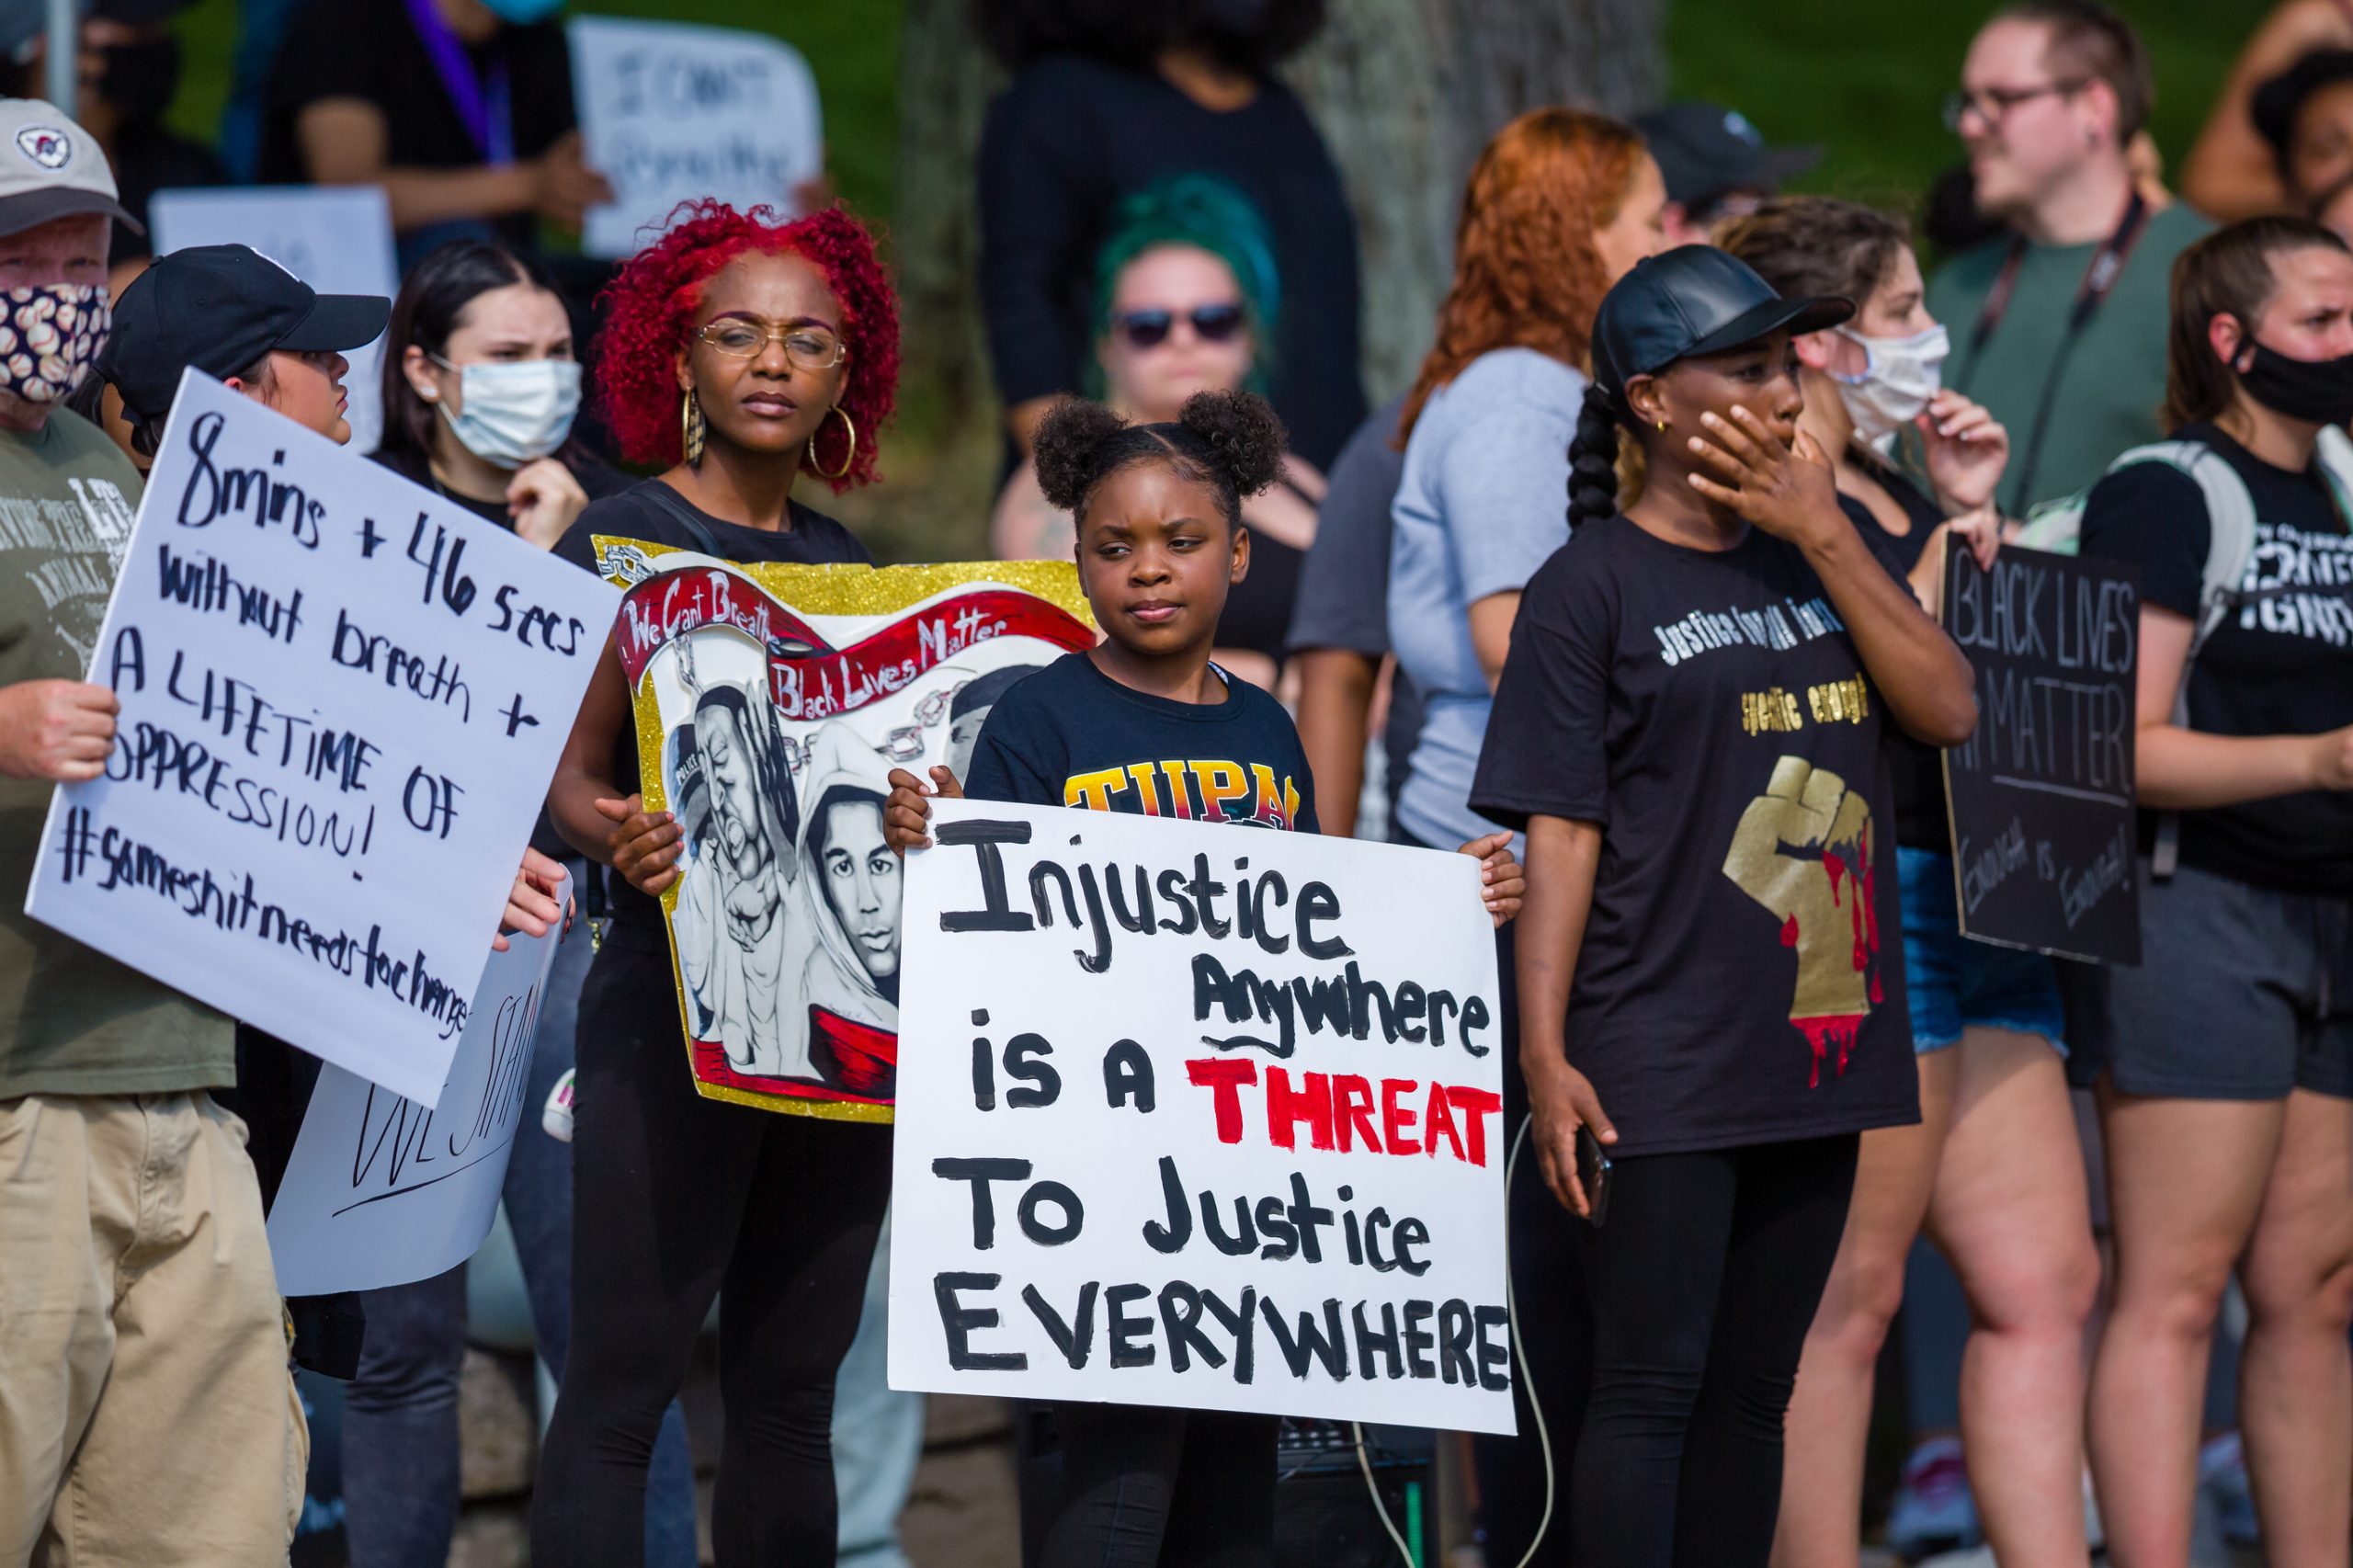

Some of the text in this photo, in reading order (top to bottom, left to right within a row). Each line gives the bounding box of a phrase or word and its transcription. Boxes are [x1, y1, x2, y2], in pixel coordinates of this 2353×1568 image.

[176, 411, 326, 551] 8mins
[406, 511, 476, 616] 46
[487, 585, 585, 656] secs
[158, 544, 303, 644] without
[332, 608, 470, 723] breath
[622, 597, 661, 653] We
[771, 606, 1008, 721] Black Lives Matter
[1654, 608, 1744, 667] Justice
[1951, 545, 2048, 660] BLACK
[2057, 569, 2135, 675] LIVES
[110, 626, 466, 839] A LIFETIME OF
[1984, 666, 2133, 794] MATTER
[104, 722, 376, 881] OPPRESSION!
[935, 818, 1357, 974] Injustice
[1191, 951, 1491, 1060] Anywhere
[971, 1007, 1503, 1169] is A THREAT
[1142, 1154, 1432, 1278] Justice
[932, 1270, 1512, 1392] EVERYWHERE
